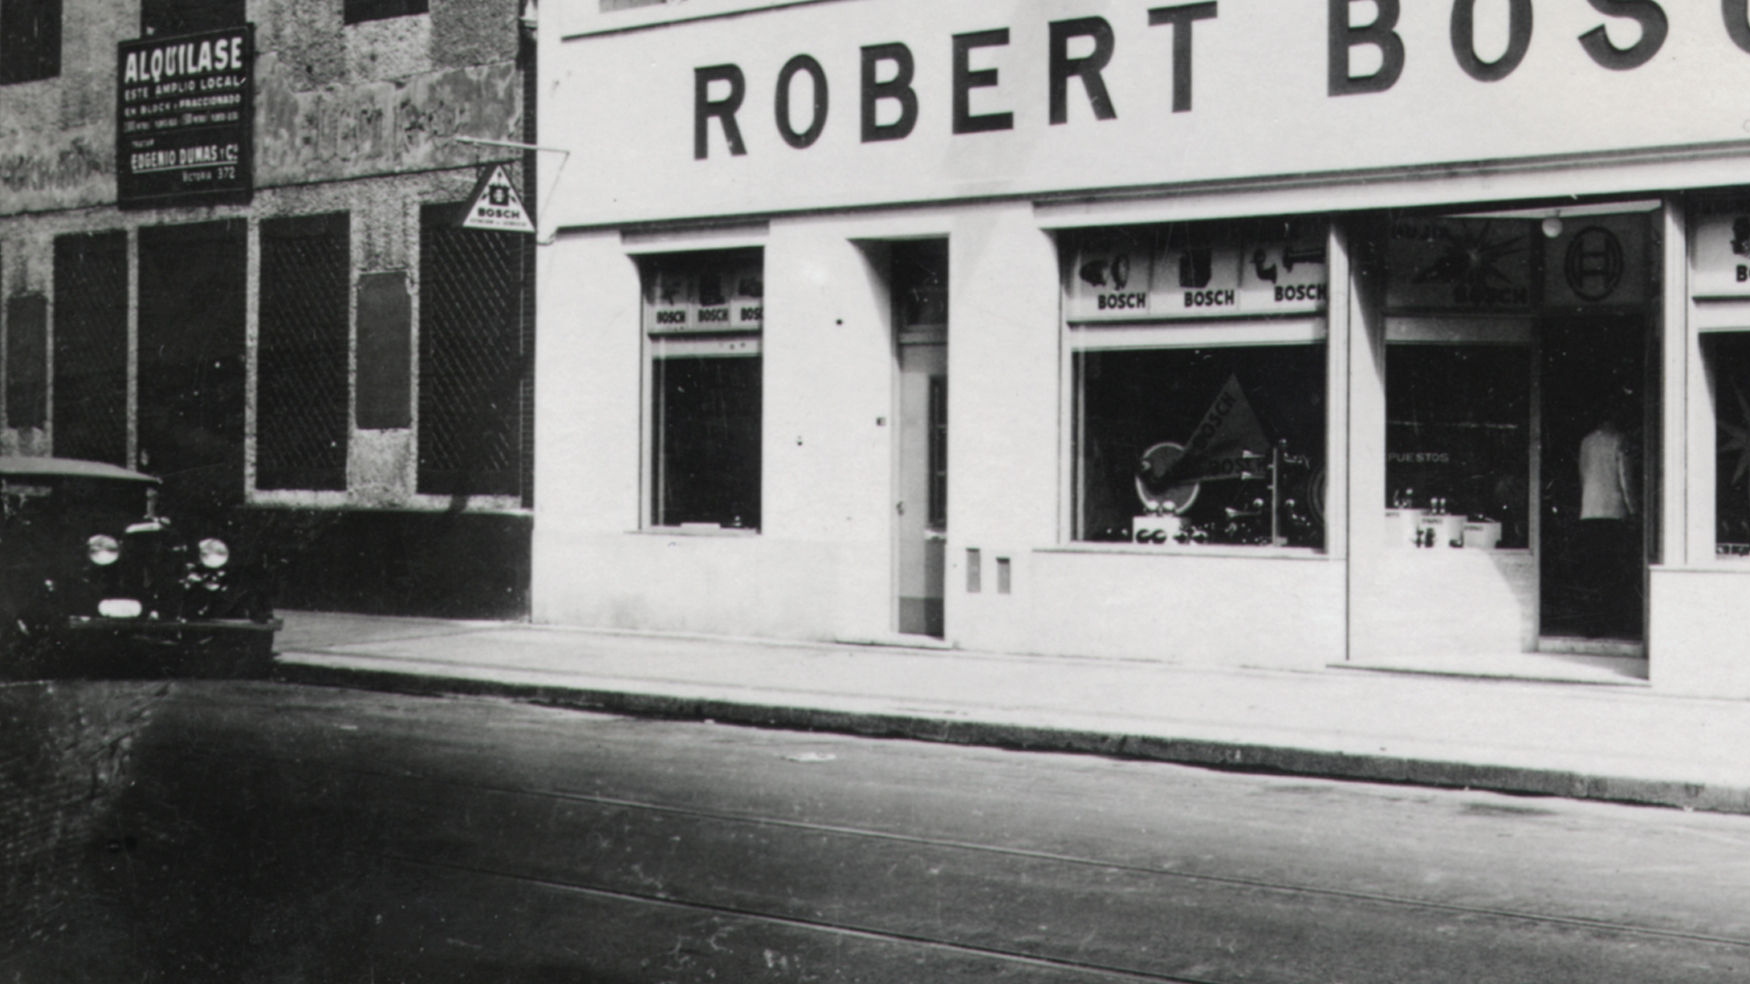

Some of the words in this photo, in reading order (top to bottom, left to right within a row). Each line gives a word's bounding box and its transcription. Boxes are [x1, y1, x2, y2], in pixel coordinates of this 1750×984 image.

[124, 37, 242, 83] ALQUILASE
[124, 88, 148, 101] ESTE
[155, 80, 195, 95] AMPLIO
[693, 0, 1219, 161] ROBERT
[1097, 292, 1146, 310] BOSCH
[1183, 289, 1235, 308] BOSCH
[1274, 284, 1327, 302] BOSCH
